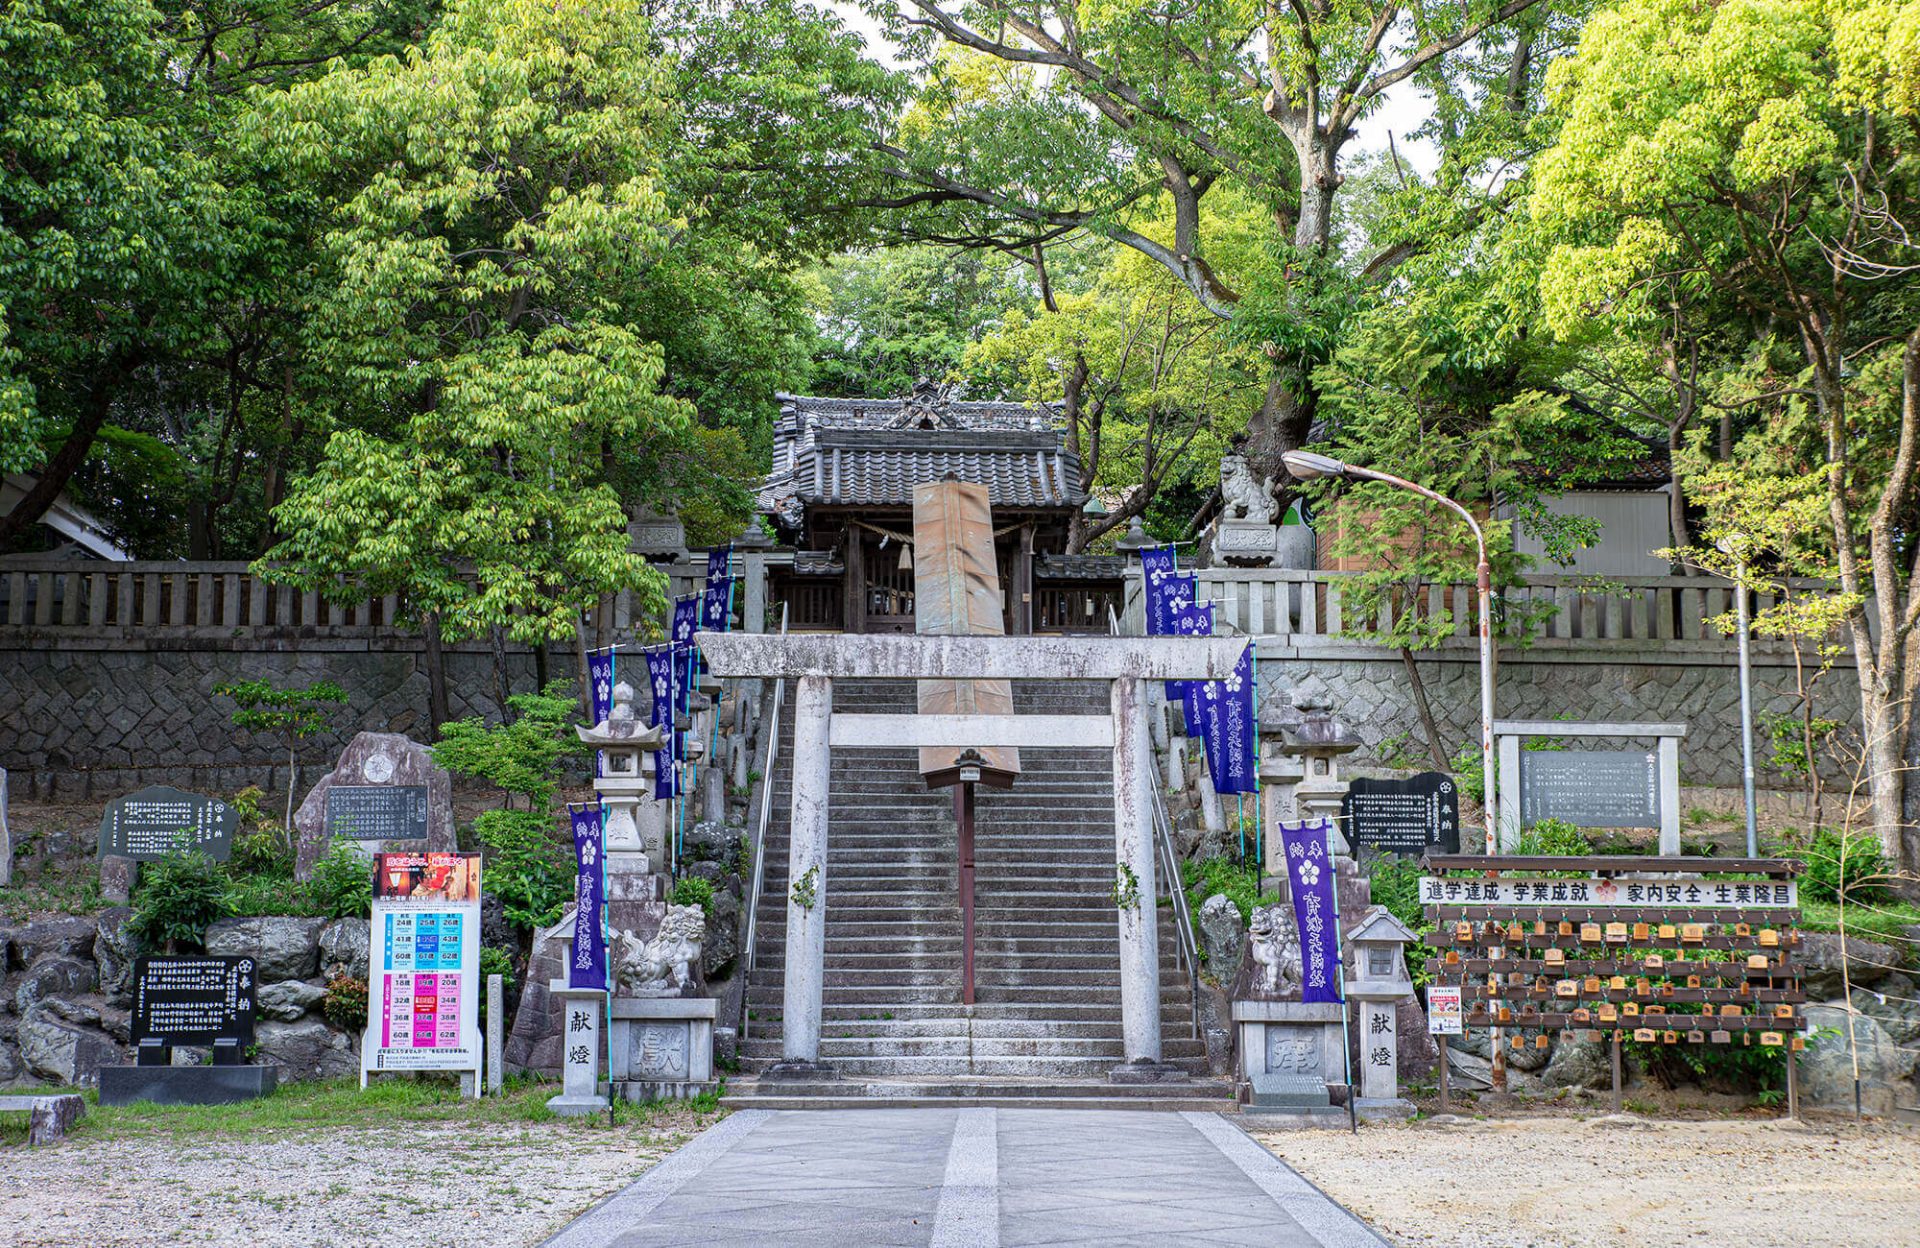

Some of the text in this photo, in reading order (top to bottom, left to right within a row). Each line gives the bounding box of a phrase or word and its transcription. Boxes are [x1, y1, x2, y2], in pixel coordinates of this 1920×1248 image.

[576, 820, 599, 840] 奉納
[1289, 840, 1323, 859] 奉納
[569, 1011, 592, 1064] 献燈
[1371, 1013, 1392, 1066] 献燈
